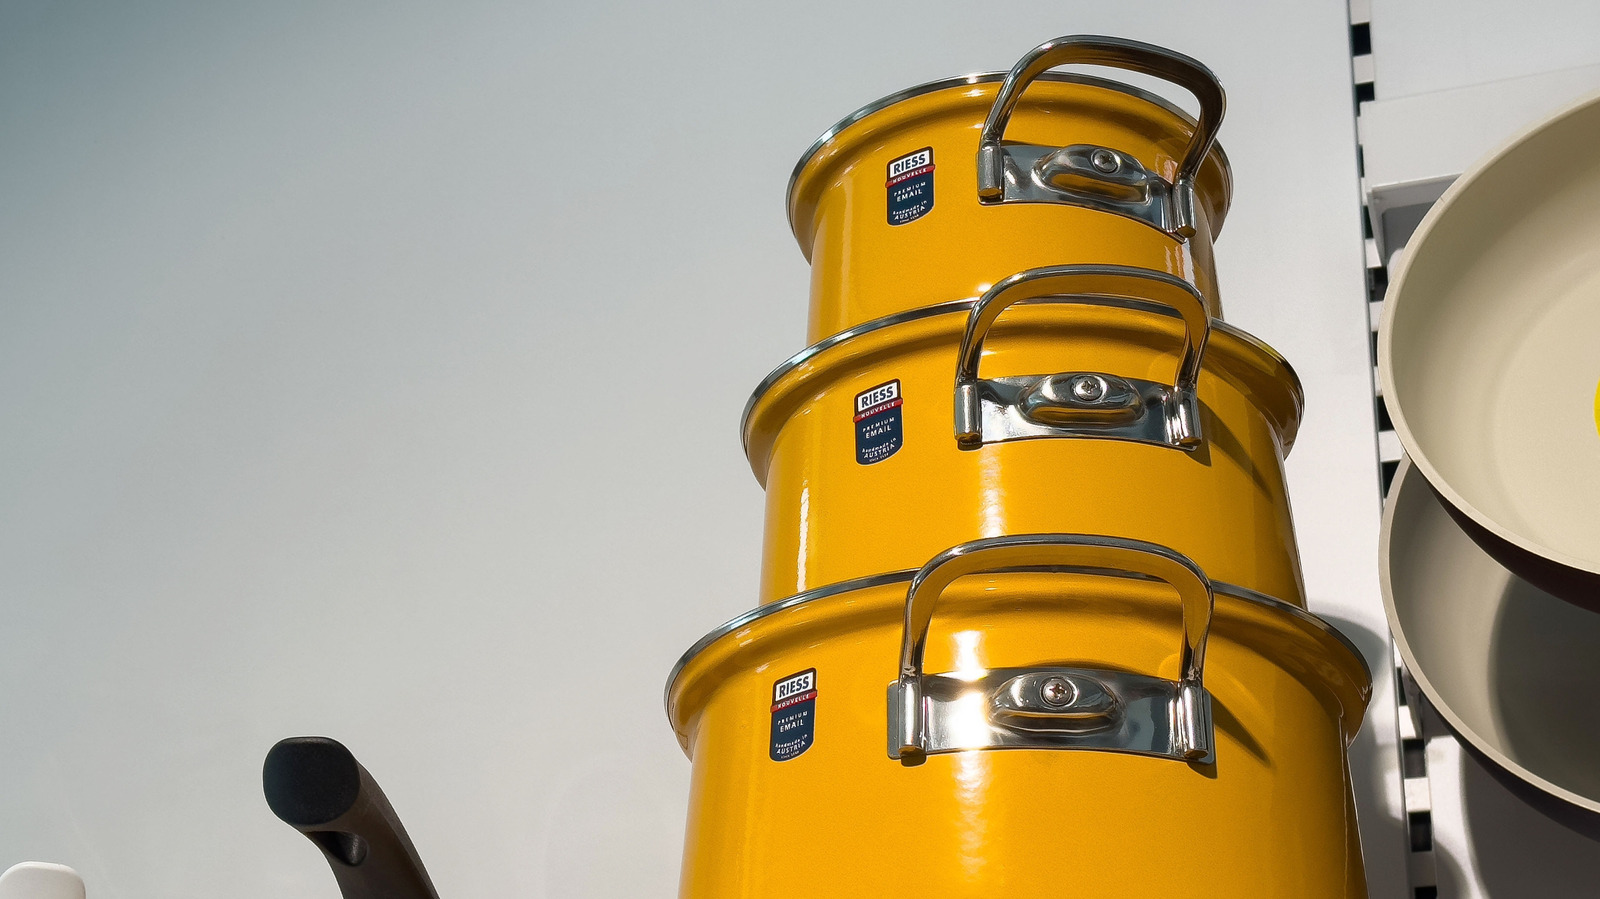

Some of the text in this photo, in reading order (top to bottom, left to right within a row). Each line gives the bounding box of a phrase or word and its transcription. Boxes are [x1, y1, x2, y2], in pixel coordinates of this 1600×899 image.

[893, 153, 926, 175] RIESS
[892, 168, 927, 184] NOUVELLE
[894, 181, 926, 197] PREMIUM
[896, 188, 923, 202] EMAIL
[894, 206, 925, 220] AUSTRIA
[861, 386, 894, 409] RIESS
[861, 401, 895, 419] NOUVELLE
[862, 417, 895, 433] PREMIUM
[865, 425, 892, 439] EMAIL
[864, 443, 895, 459] AUSTRIA
[779, 675, 810, 698] RIESS
[777, 694, 810, 709] NOUVELLE
[777, 711, 808, 725] PREMIUM
[780, 719, 804, 733] EMAIL
[776, 740, 806, 754] AUSTRIA
